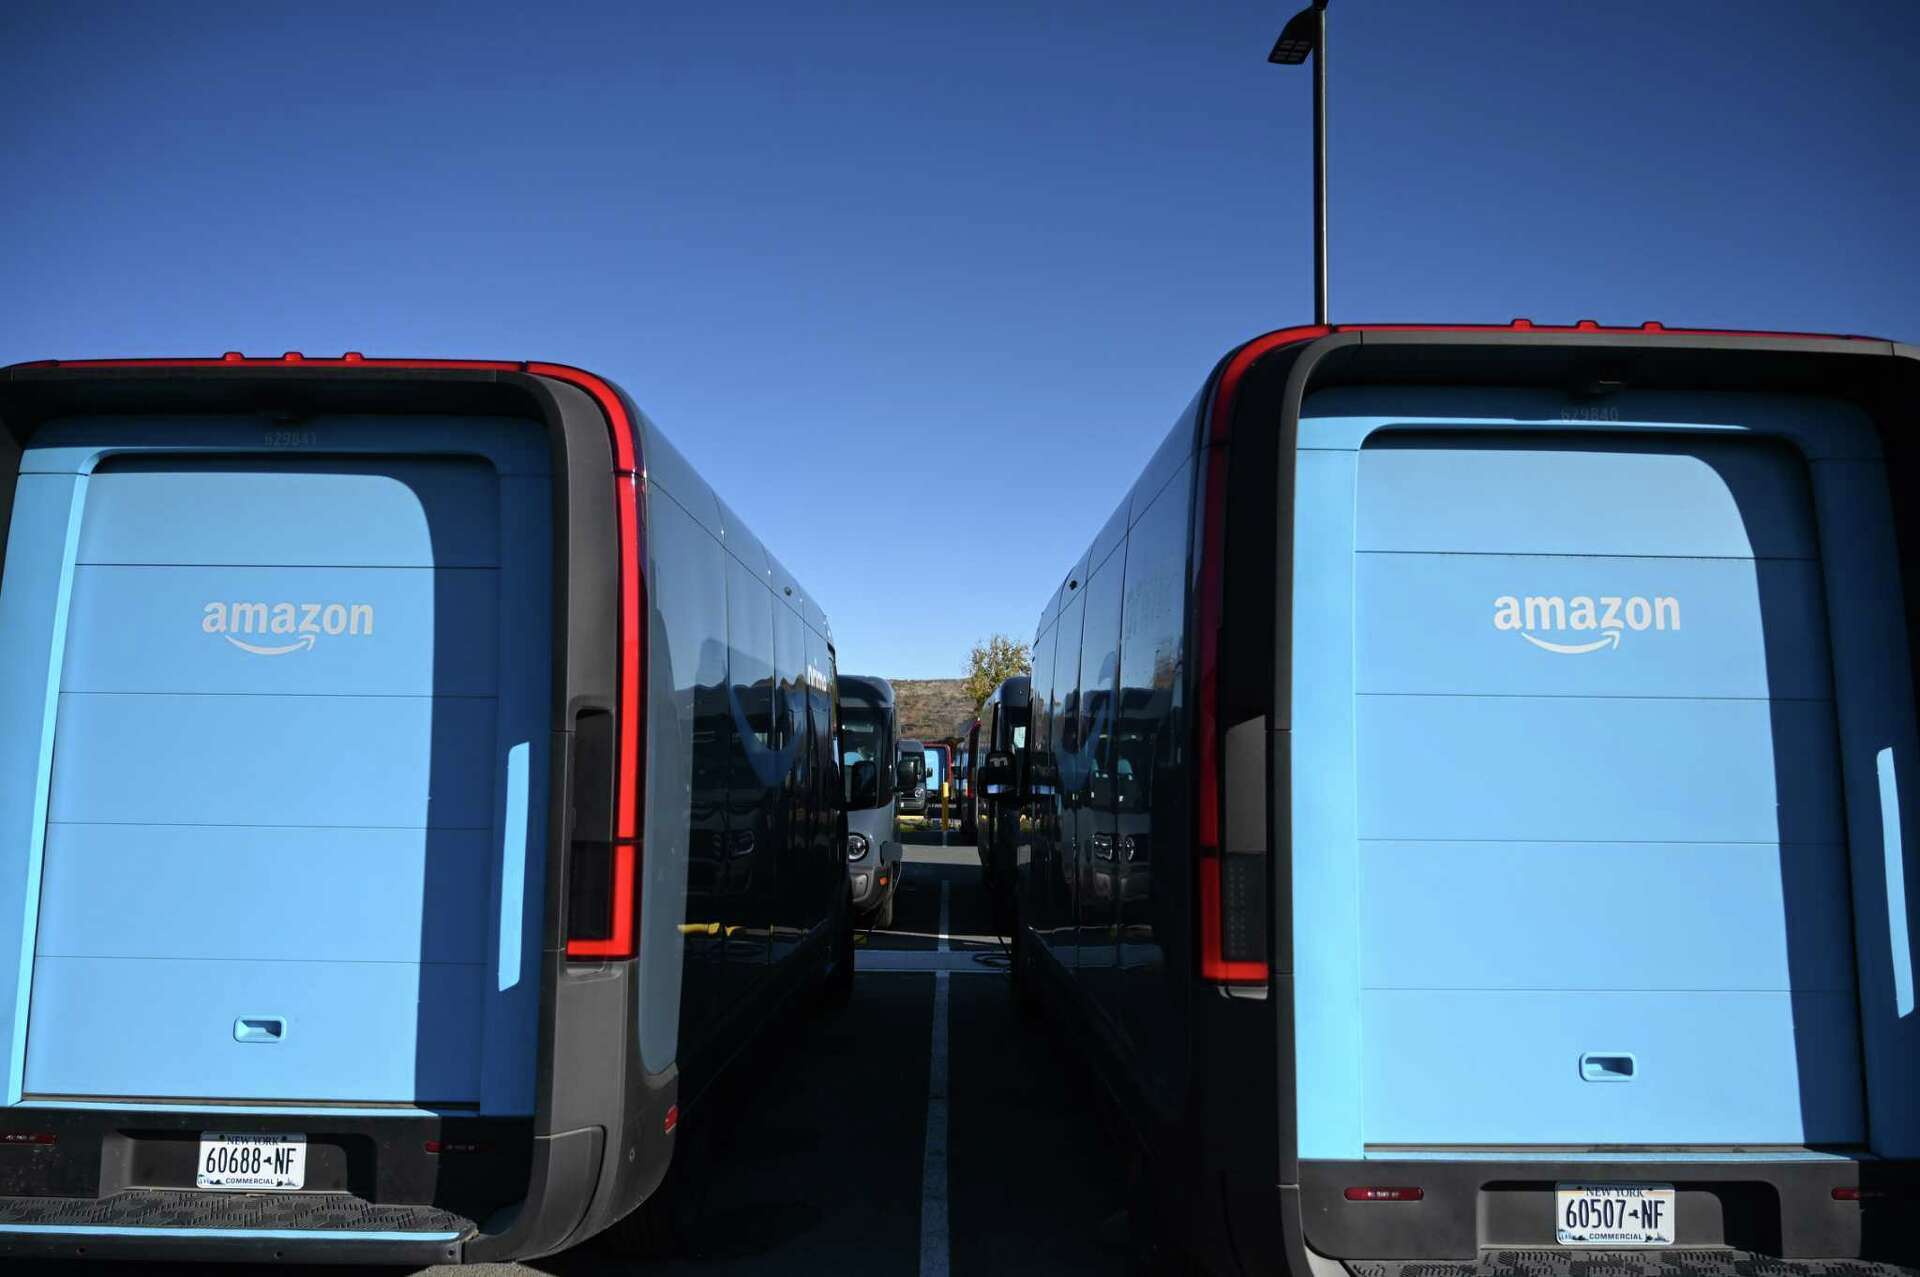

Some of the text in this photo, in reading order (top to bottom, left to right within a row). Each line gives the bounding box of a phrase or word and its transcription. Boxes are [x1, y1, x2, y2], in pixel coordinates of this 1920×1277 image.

[202, 602, 374, 636] amazon
[1493, 595, 1681, 631] amazon
[227, 1135, 280, 1146] NEW YORK
[206, 1147, 297, 1175] 60688 NF
[1586, 1186, 1645, 1198] NEW YORK
[1566, 1199, 1666, 1230] 60507 NF
[1588, 1232, 1643, 1241] COMMERCIAL
